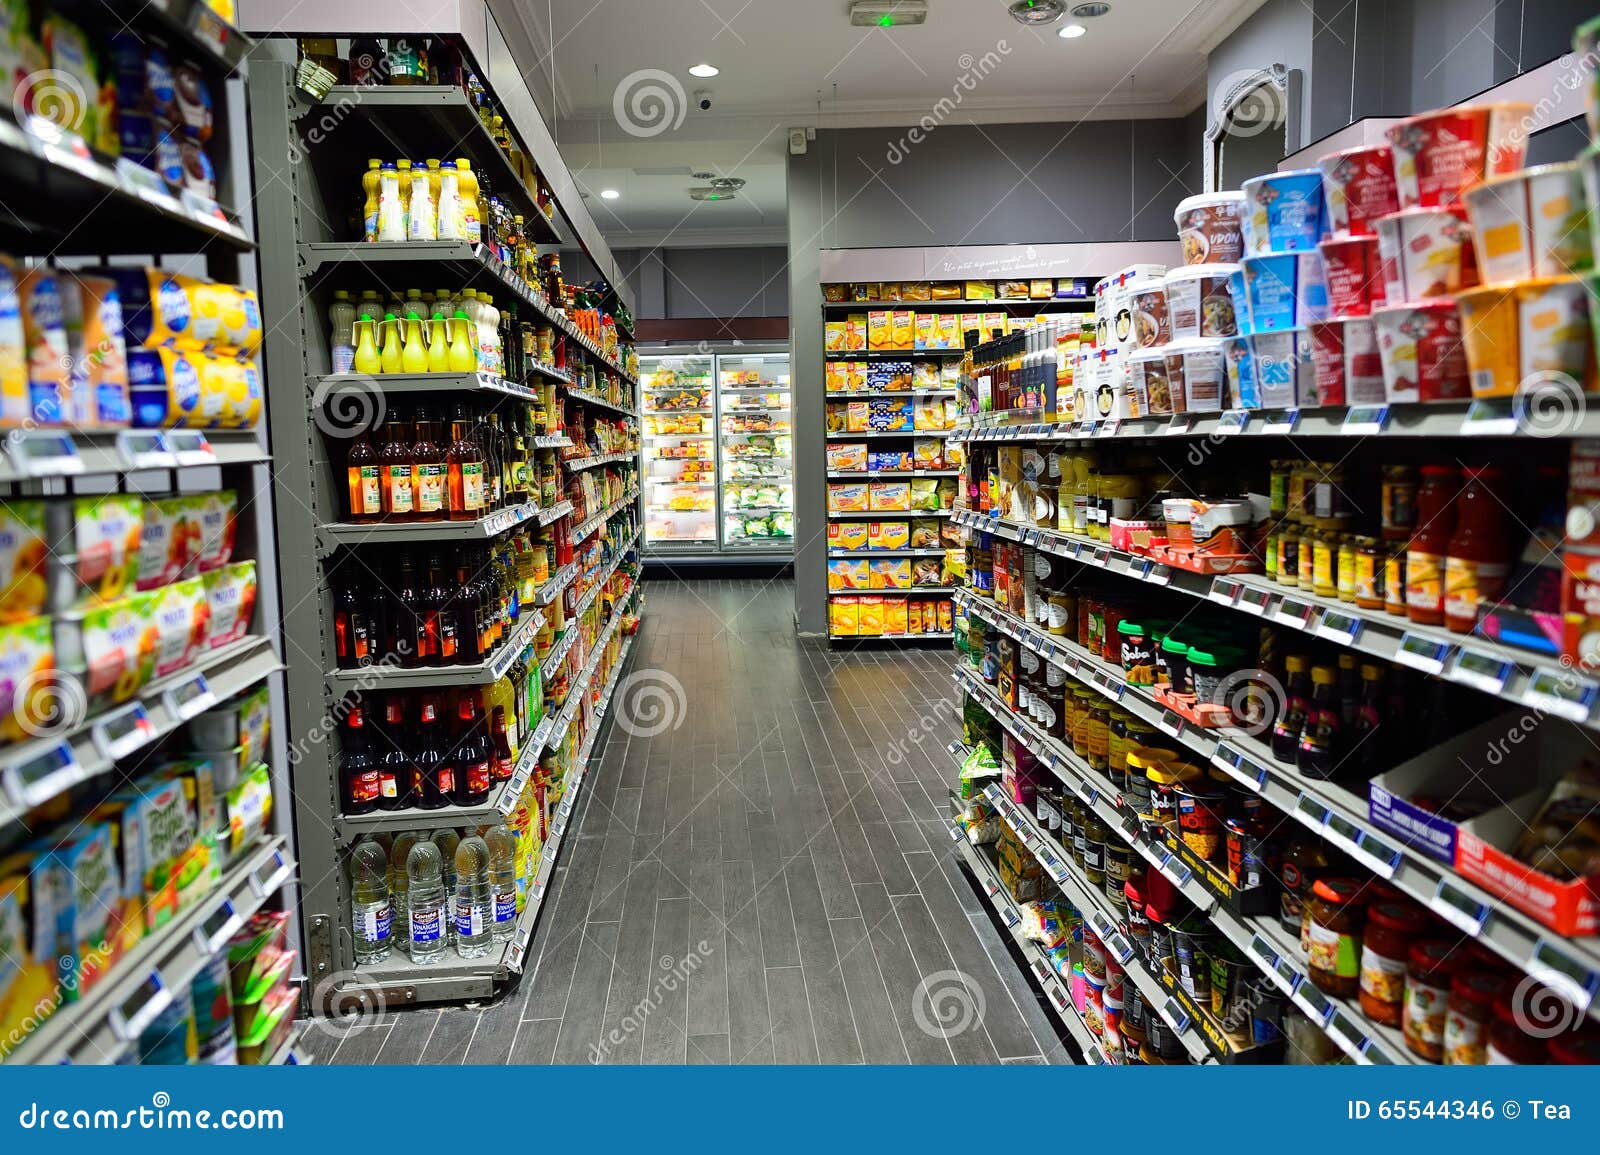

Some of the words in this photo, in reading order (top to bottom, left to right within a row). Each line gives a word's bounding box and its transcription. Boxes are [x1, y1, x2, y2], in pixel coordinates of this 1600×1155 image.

[1209, 232, 1241, 245] UDON
[1121, 642, 1150, 661] Soba
[1151, 789, 1176, 809] Soba
